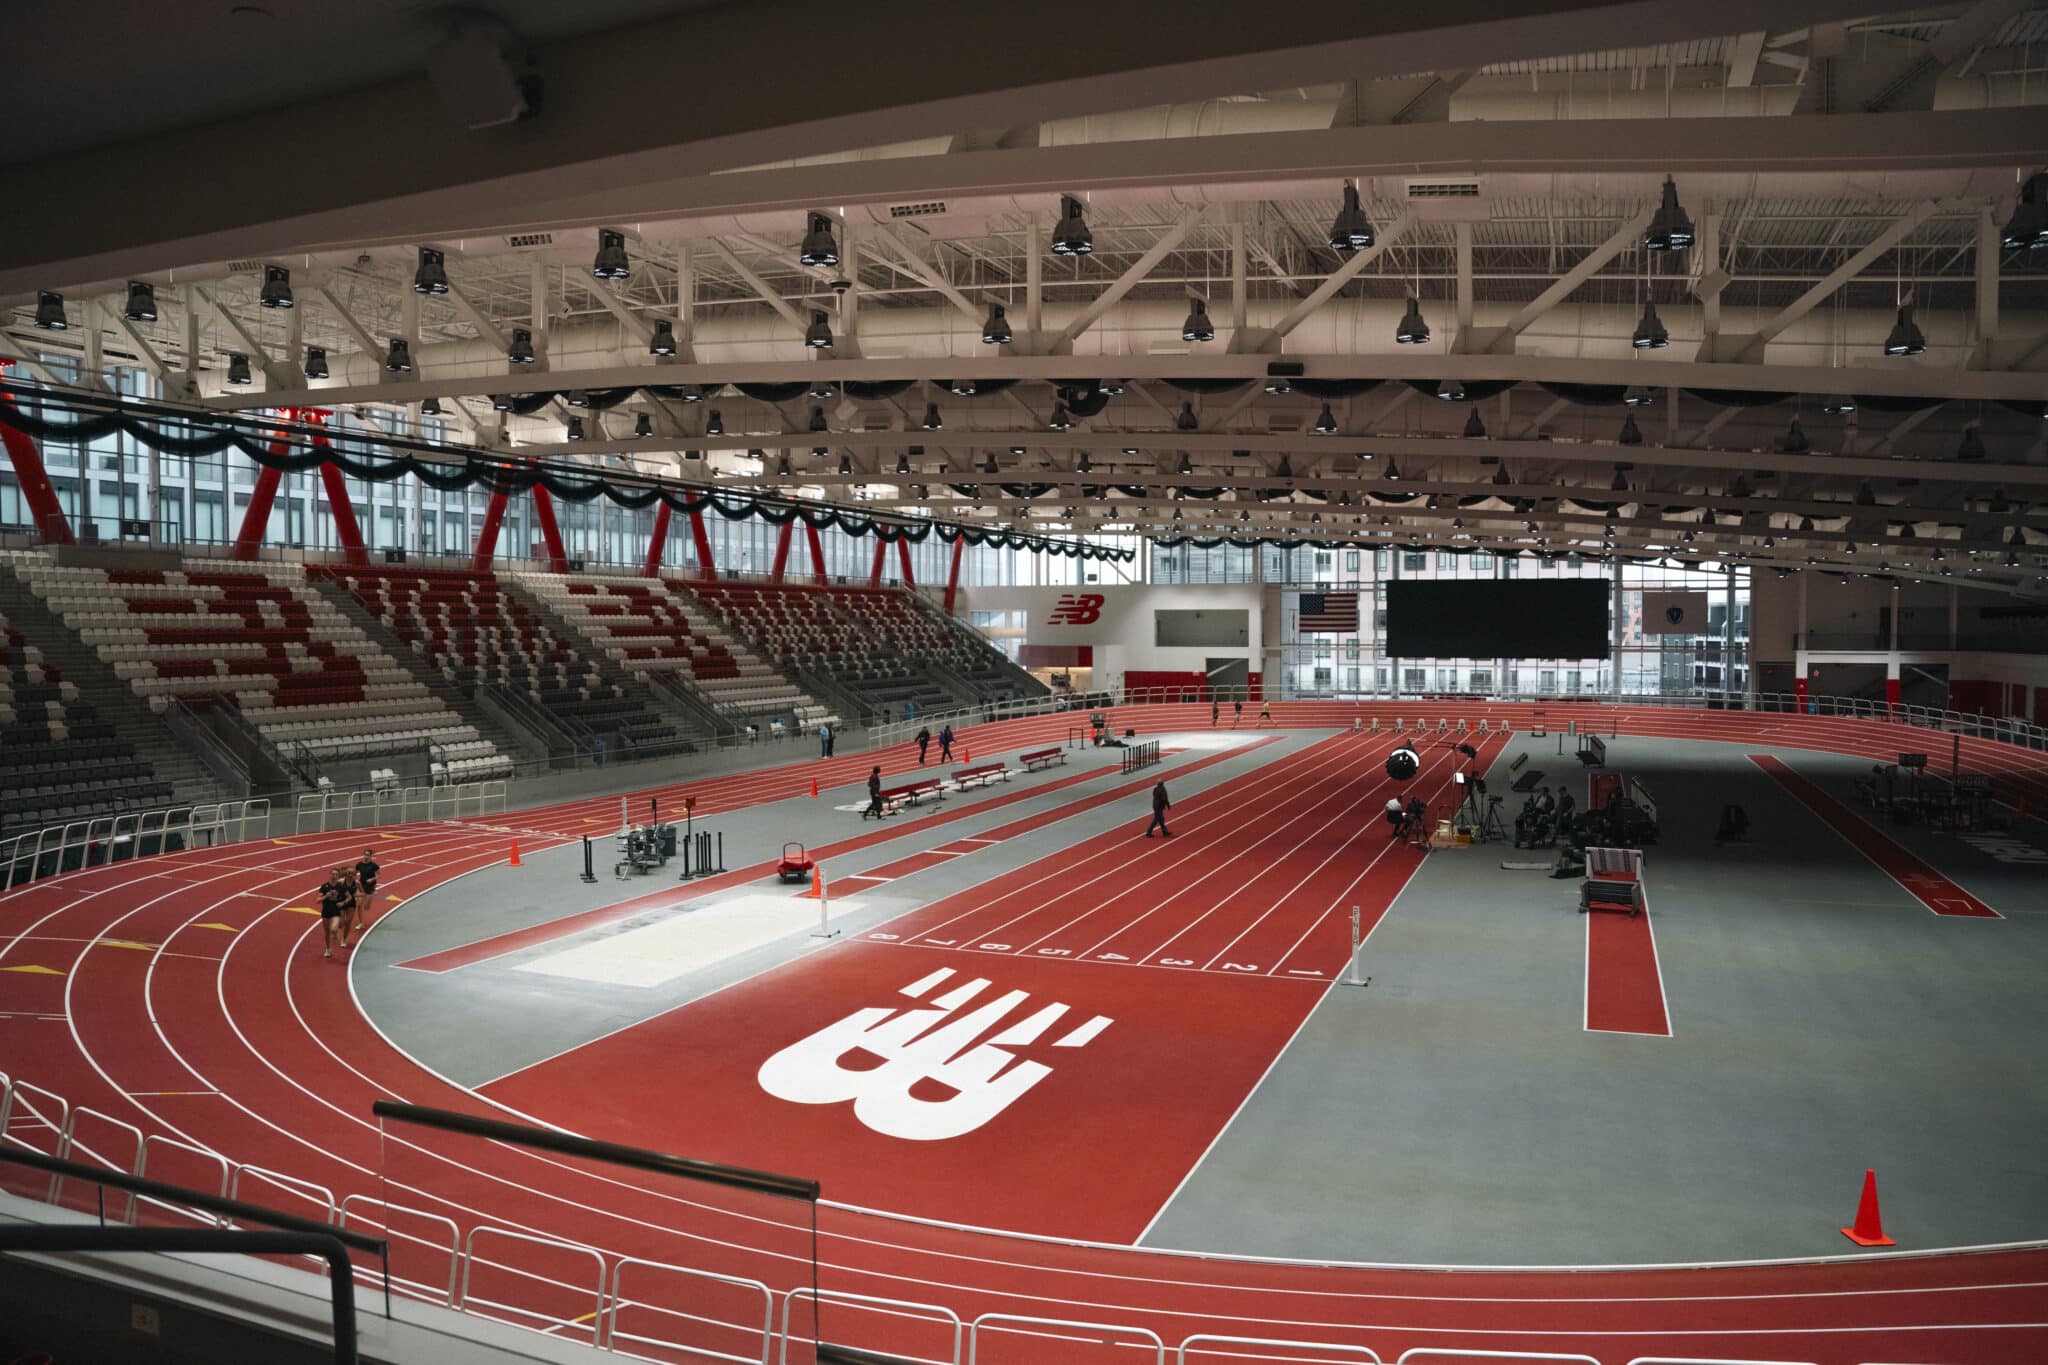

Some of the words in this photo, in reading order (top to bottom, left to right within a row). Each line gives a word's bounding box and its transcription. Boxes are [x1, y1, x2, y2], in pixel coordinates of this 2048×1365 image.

[1047, 594, 1105, 624] NB
[868, 932, 899, 941] 8
[925, 938, 957, 947] 7
[979, 943, 1012, 951] 6
[1037, 947, 1070, 957] 5
[1097, 952, 1131, 962] 4
[1160, 958, 1194, 967] 3
[1222, 962, 1259, 972] 2
[1288, 968, 1324, 977] 1
[757, 967, 1114, 1140] NB
